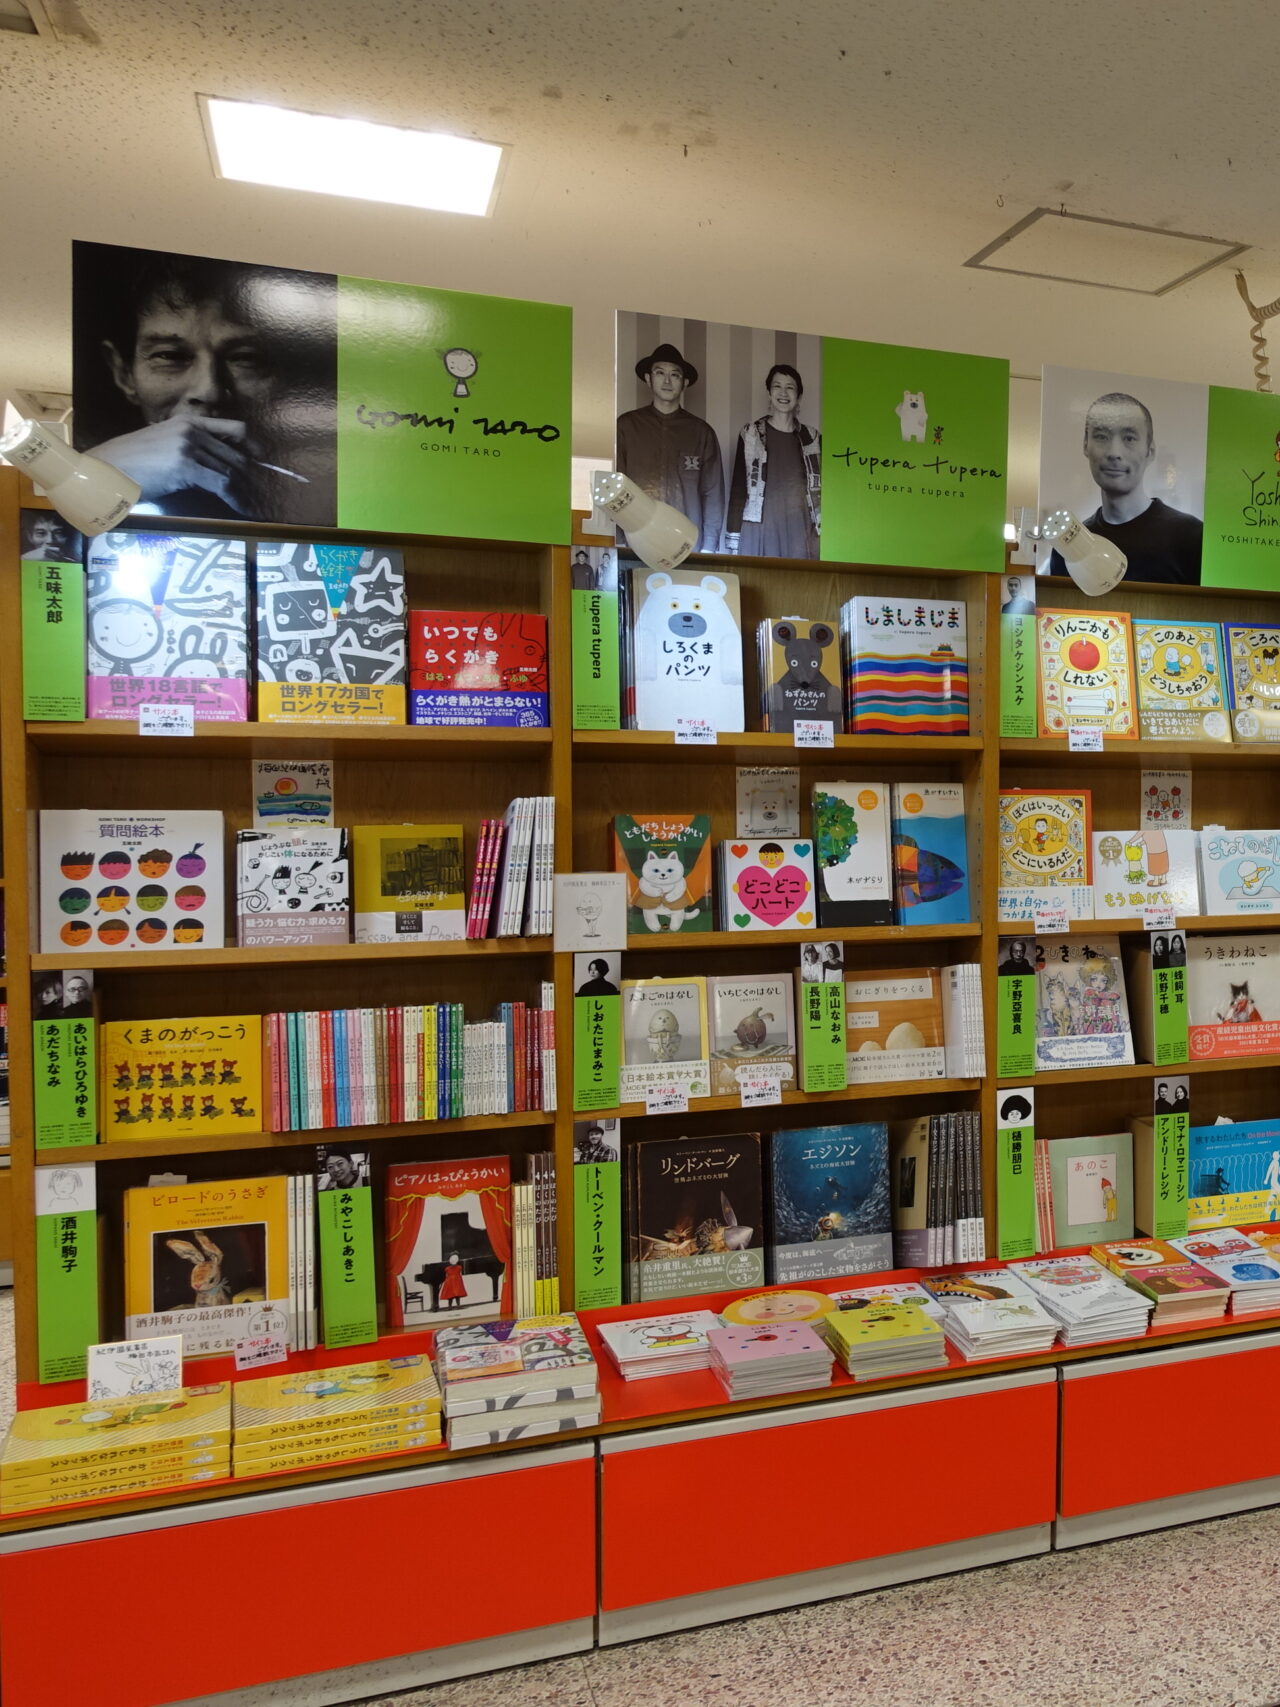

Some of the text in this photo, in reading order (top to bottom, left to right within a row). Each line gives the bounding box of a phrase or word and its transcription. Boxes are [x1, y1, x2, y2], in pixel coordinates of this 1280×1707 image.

[421, 443, 501, 458] GOMI TARO
[831, 446, 1001, 479] tupera tupera
[868, 481, 966, 498] tupera tupera
[1220, 534, 1280, 547] YOSHITAKE
[46, 566, 63, 624] 五味太郎
[864, 604, 960, 629] しましまじま
[424, 625, 498, 641] いつでも
[589, 595, 601, 679] tupera tupera
[1054, 620, 1110, 639] りんごかも
[1154, 630, 1196, 646] このあと
[663, 640, 713, 655] しろくま
[424, 650, 499, 665] らくがき
[1014, 617, 1024, 706] ヨシタケシンスケ
[666, 665, 710, 677] パンツ
[1063, 672, 1108, 687] しれない
[110, 679, 222, 694] 世界18言語で
[1150, 674, 1208, 696] どうしちゃおう
[281, 702, 383, 714] ロングセラー!
[1012, 801, 1071, 820] ぼくはいったい
[99, 824, 165, 838] 質問絵本
[624, 822, 703, 839] ともだち しょうかい
[642, 832, 687, 842] しょうかい
[1011, 849, 1073, 868] どこにいるんだ
[744, 879, 800, 894] どこどこ
[752, 897, 795, 910] ハート
[1204, 946, 1268, 961] うきわねこ
[629, 990, 694, 1002] たまごのはなし
[718, 987, 782, 998] いちじくのはなし
[855, 985, 924, 996] おにぎりをつくる
[1158, 972, 1169, 1015] 牧野千穂
[809, 986, 822, 1030] 長野陽一
[829, 986, 841, 1045] 高山なおみ
[1011, 980, 1023, 1035] 宇野亞喜良
[123, 1023, 247, 1045] くまのがっこう
[592, 1000, 604, 1082] しおたにまみこ
[46, 1024, 61, 1088] あだちなみ
[74, 1023, 88, 1118] あいはらひろゆき
[801, 1143, 862, 1161] エジソン
[1011, 1131, 1022, 1175] 樋勝朋巳
[1160, 1117, 1171, 1201] アンドリー・レシヴ
[1175, 1116, 1185, 1203] ロマナ・ロマニーシン
[660, 1153, 740, 1176] リンドバーグ
[1074, 1159, 1108, 1171] あのこ
[394, 1166, 505, 1187] ピアノはっぴょうかい
[152, 1186, 269, 1207] ビロードのうさぎ
[592, 1167, 605, 1277] トーベン・クールマン
[60, 1216, 78, 1273] 酒井駒子
[340, 1193, 356, 1284] みやこしあきこ
[136, 1307, 252, 1328] 酒井駒子の最高傑作!
